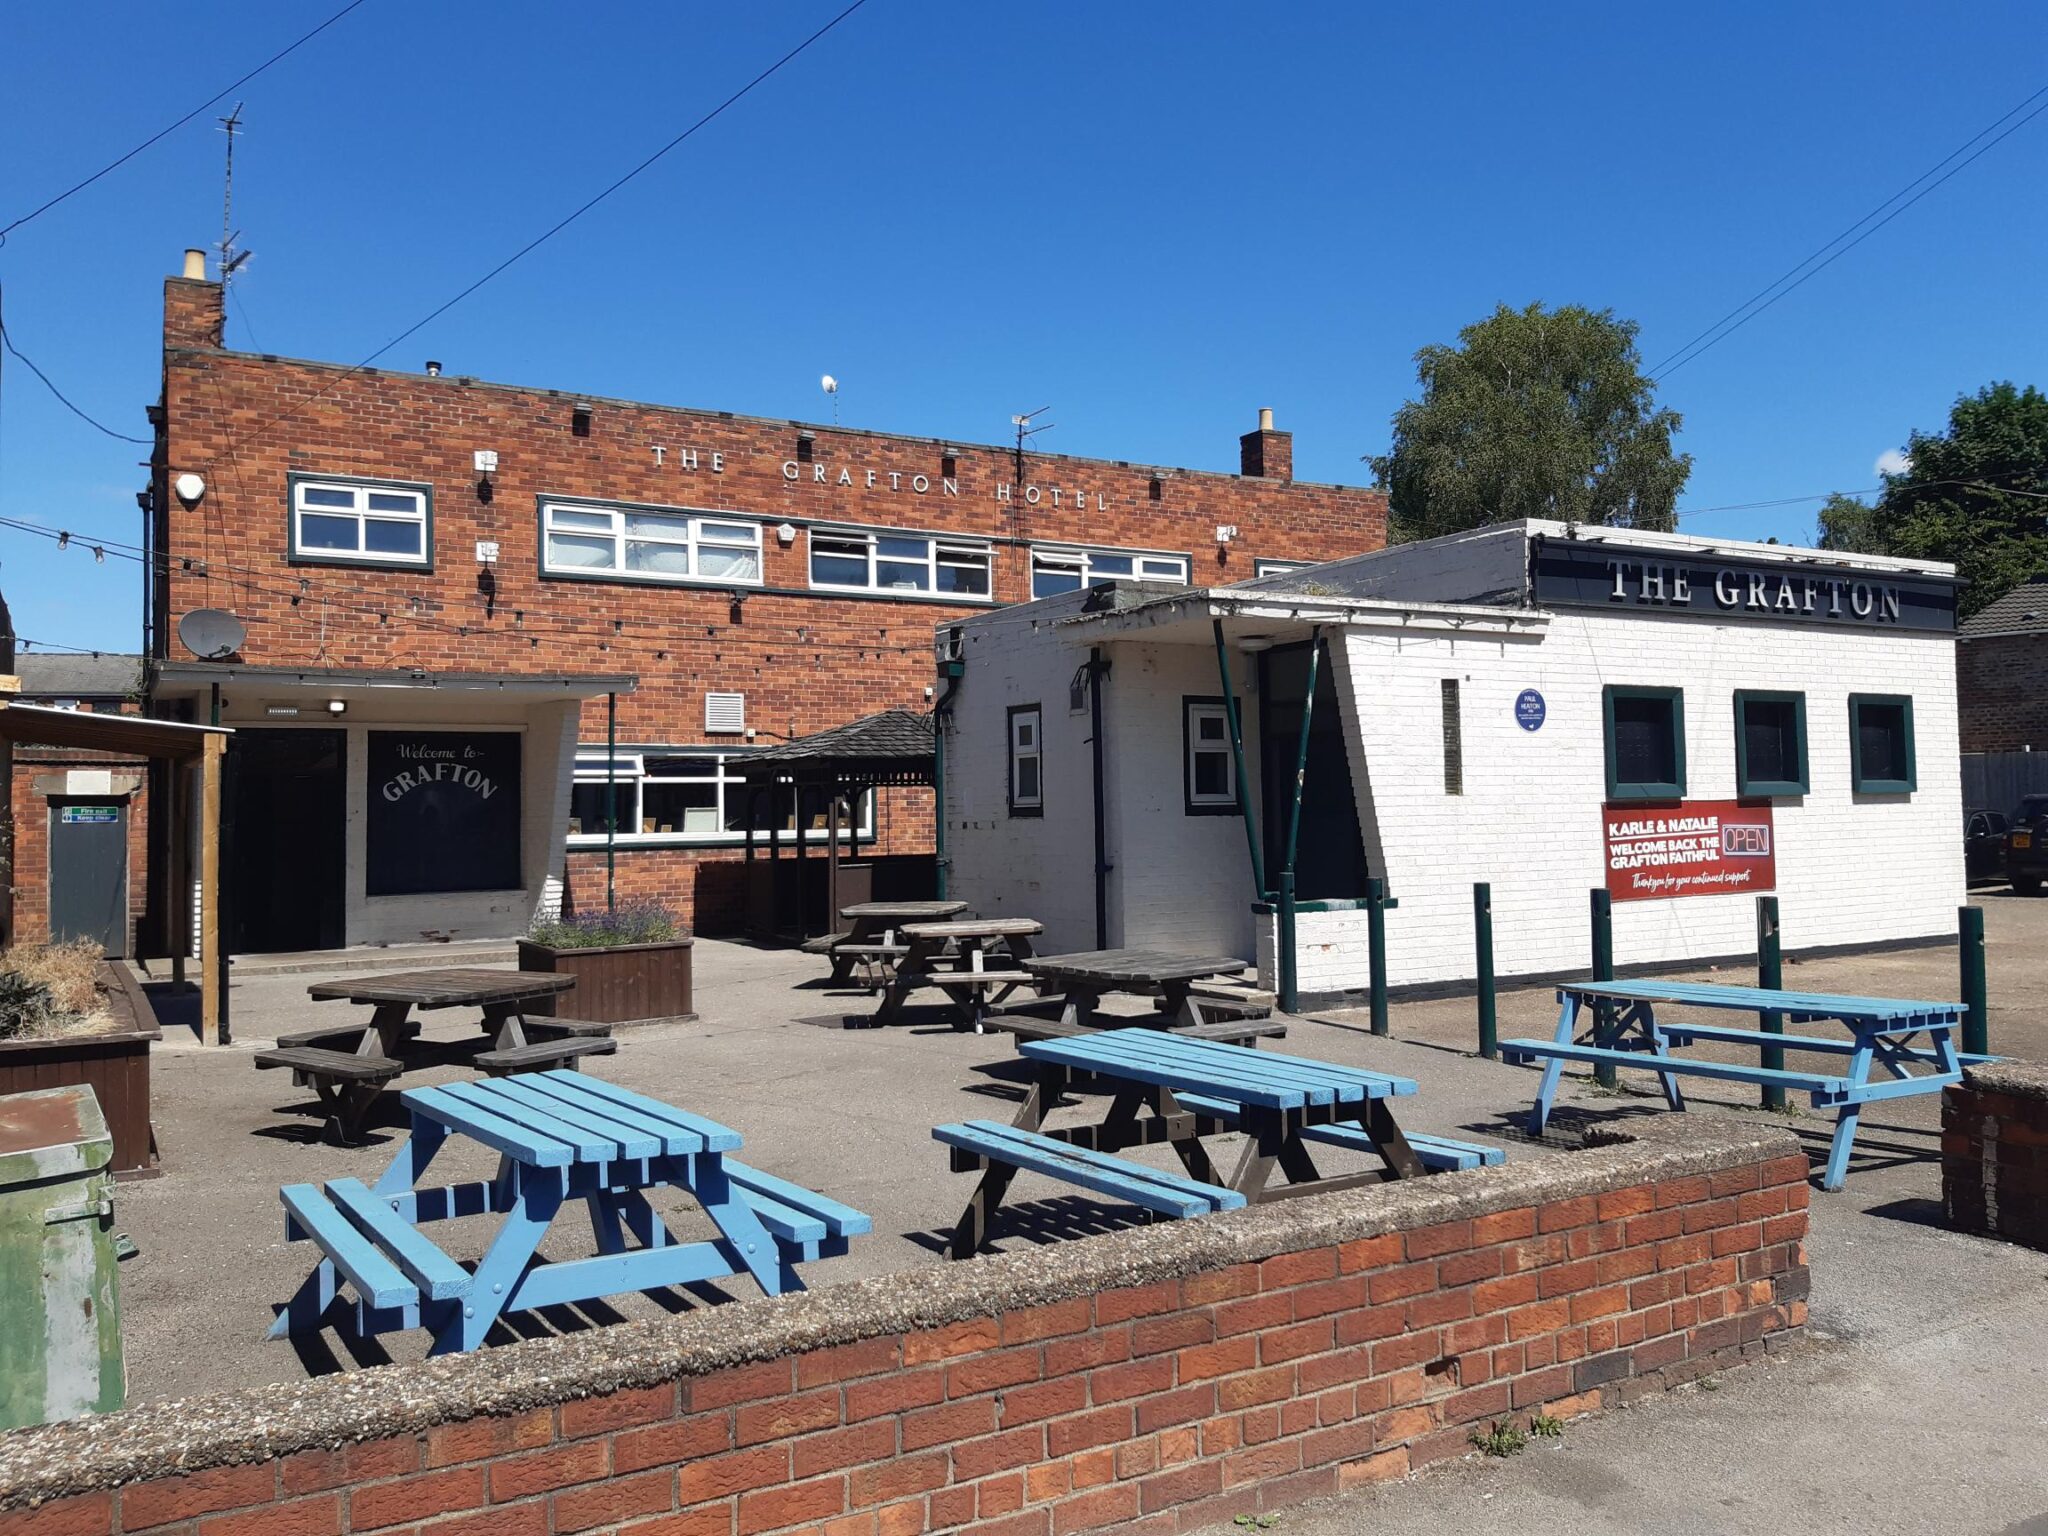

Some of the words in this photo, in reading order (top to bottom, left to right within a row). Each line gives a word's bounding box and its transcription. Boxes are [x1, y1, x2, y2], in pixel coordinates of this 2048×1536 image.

[652, 446, 725, 472] THE
[783, 461, 957, 496] GRAFTON
[997, 484, 1107, 511] HOTEL
[1607, 558, 1692, 601] THE
[1715, 569, 1899, 618] GRAFTON
[396, 744, 456, 759] Welcome
[382, 762, 499, 802] GRAFTON
[1609, 820, 1654, 837] KARLE
[1656, 820, 1667, 834] &
[1668, 817, 1719, 832] NATALIE
[1610, 841, 1667, 857] WELCOME
[1668, 839, 1698, 851] BACK
[1699, 837, 1720, 849] THE
[1725, 828, 1767, 851] OPEN
[1610, 852, 1668, 870] GRAFTON
[1669, 849, 1720, 864] FAITHFUL
[1664, 872, 1675, 889] for
[1675, 876, 1691, 891] your
[1692, 869, 1724, 885] continued
[1724, 869, 1751, 887] support
